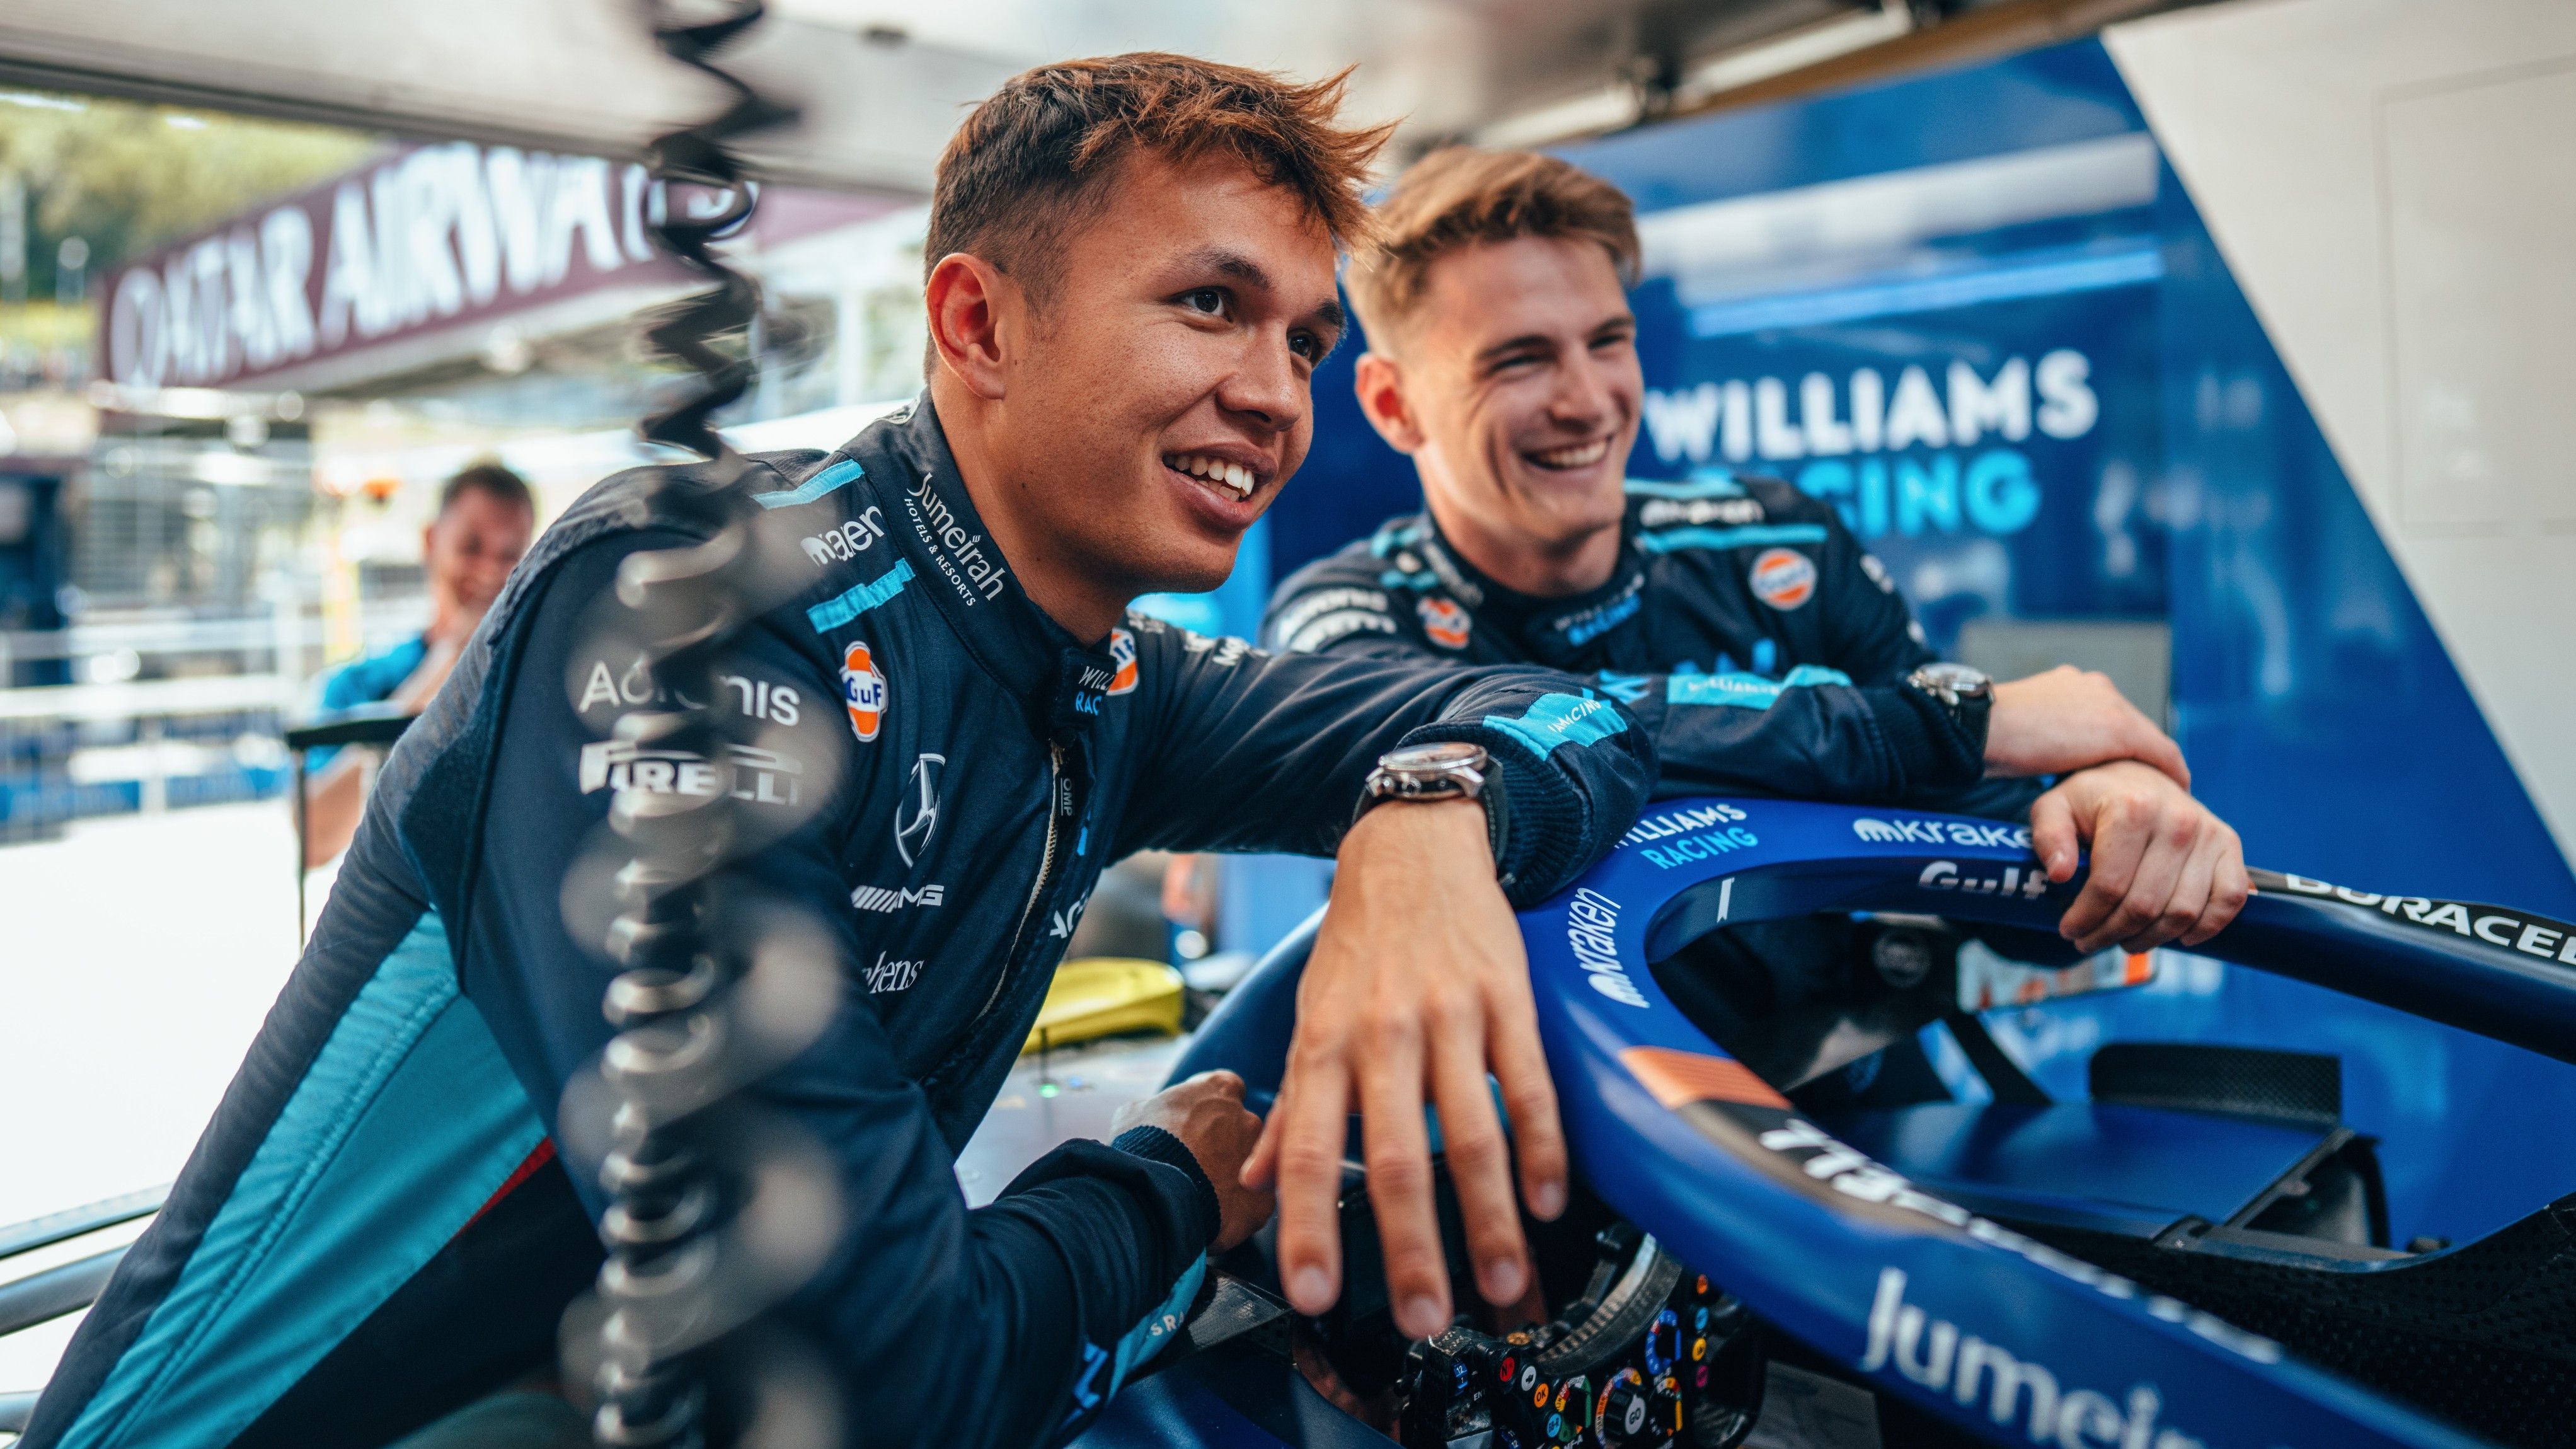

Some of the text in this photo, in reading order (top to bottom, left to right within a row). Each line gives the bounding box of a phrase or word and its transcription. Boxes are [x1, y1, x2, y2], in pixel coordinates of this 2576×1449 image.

[1642, 349, 2100, 463] WILLIAMS
[1691, 449, 2042, 538] CING
[904, 498, 975, 606] HOTELS & RESORTS
[906, 472, 1006, 601] Jumeirah
[578, 659, 800, 727] Acnis
[1078, 666, 1114, 690] WILL
[578, 739, 803, 805] PIRELLI
[1062, 778, 1072, 816] OMP
[1614, 804, 1747, 849] ILLIAMS
[1640, 827, 1758, 869] RACING
[1892, 819, 2033, 849] krake
[1918, 860, 2047, 899] Gulf
[1858, 1266, 2209, 1449] Jumei
[1537, 1388, 1546, 1402] OK
